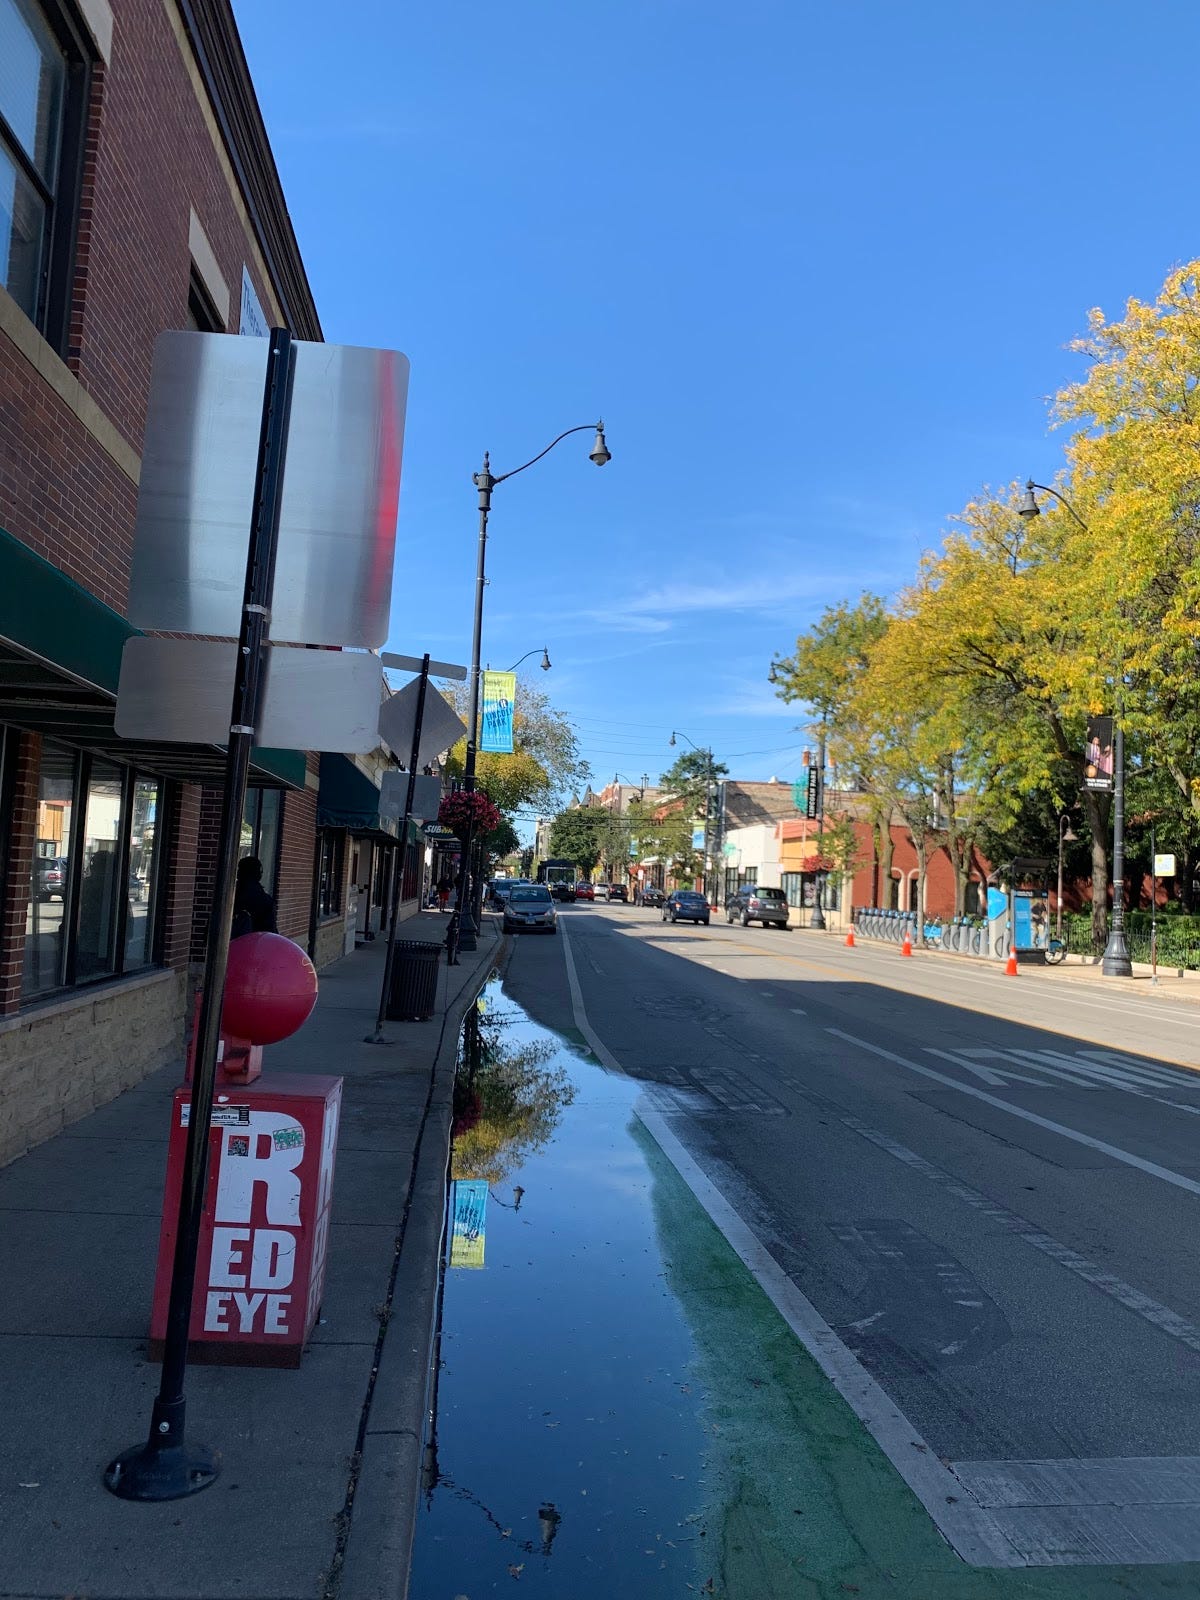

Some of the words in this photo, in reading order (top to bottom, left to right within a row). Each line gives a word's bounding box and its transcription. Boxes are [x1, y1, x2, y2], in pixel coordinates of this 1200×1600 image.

[424, 825, 454, 834] SUBWA
[215, 1111, 306, 1226] R
[208, 1226, 296, 1290] ED
[203, 1291, 292, 1335] EYE
